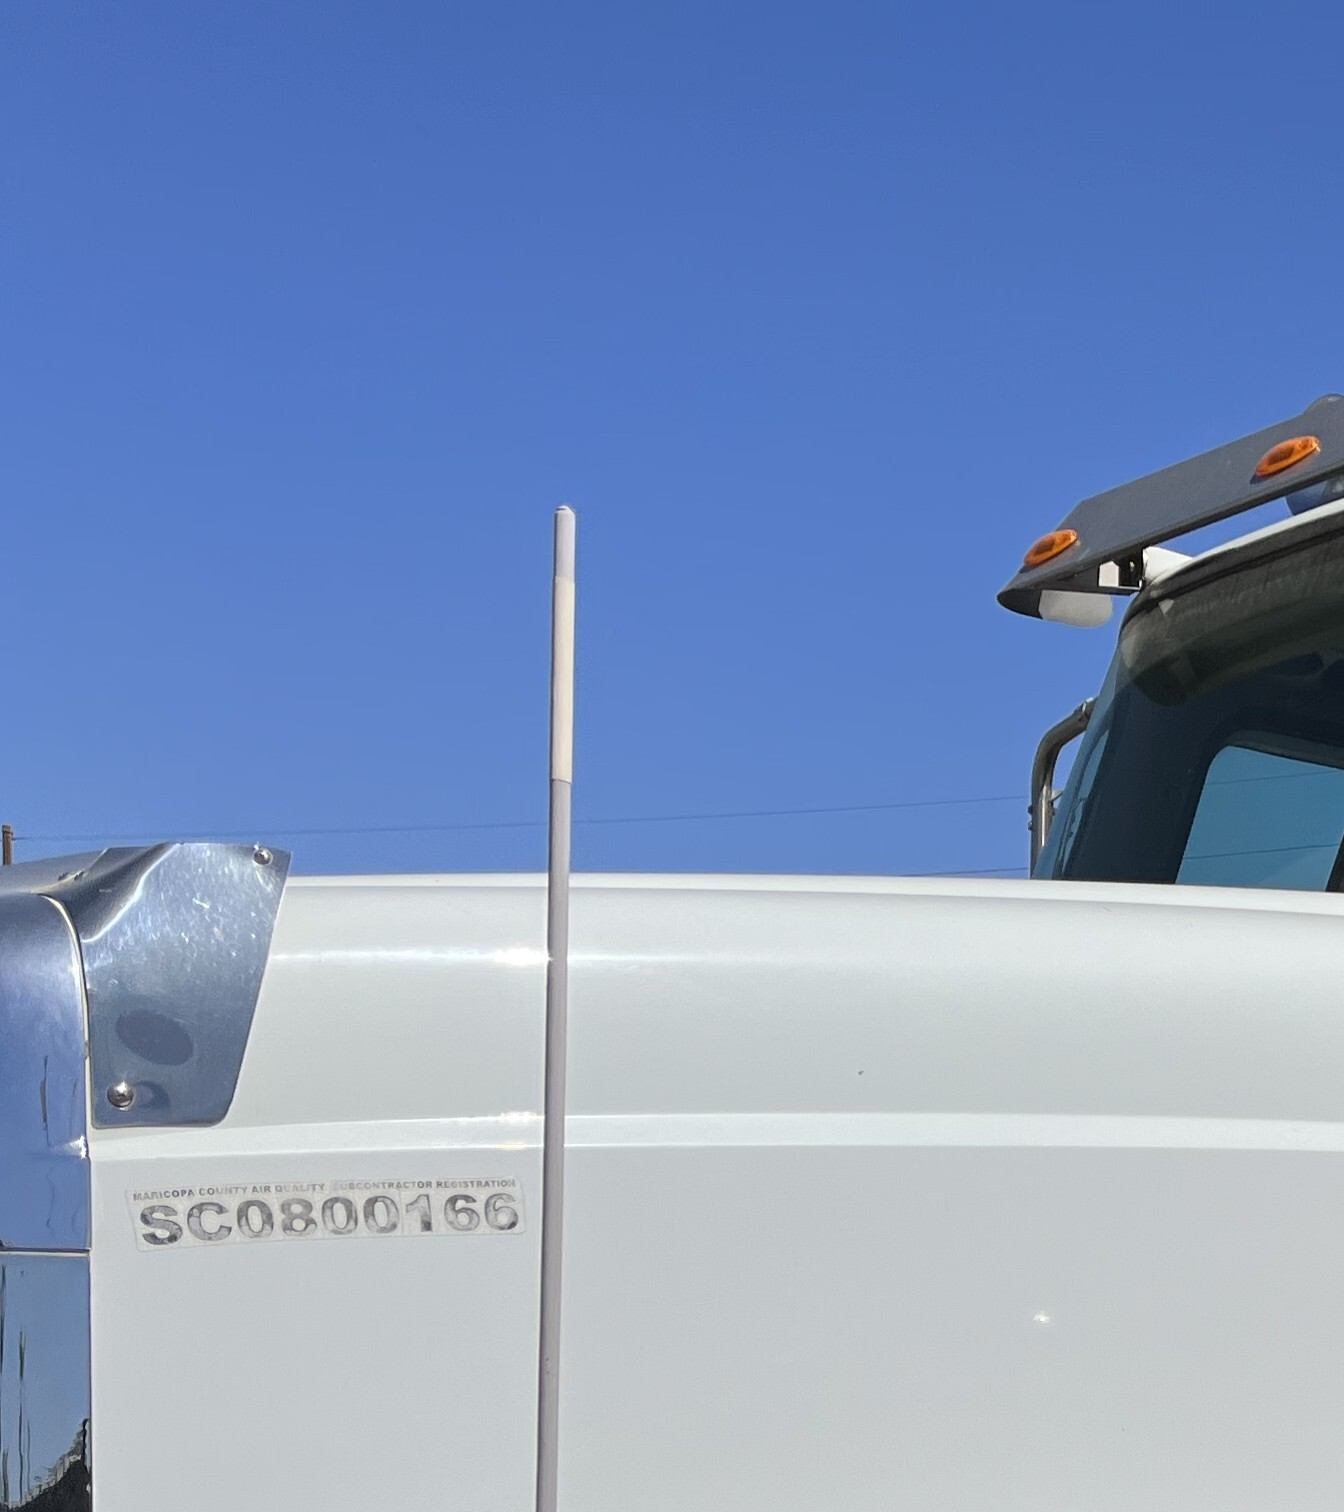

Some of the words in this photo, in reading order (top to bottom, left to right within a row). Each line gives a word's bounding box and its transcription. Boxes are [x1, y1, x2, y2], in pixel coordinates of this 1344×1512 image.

[133, 1188, 195, 1201] MARICOPA
[198, 1186, 248, 1197] COUNTY
[251, 1184, 272, 1194] AIR
[275, 1183, 326, 1193] QUALITY
[333, 1180, 433, 1191] SUBCONTRACTOR
[436, 1178, 516, 1189] REGISTRATION
[140, 1193, 519, 1246] SC0800166
